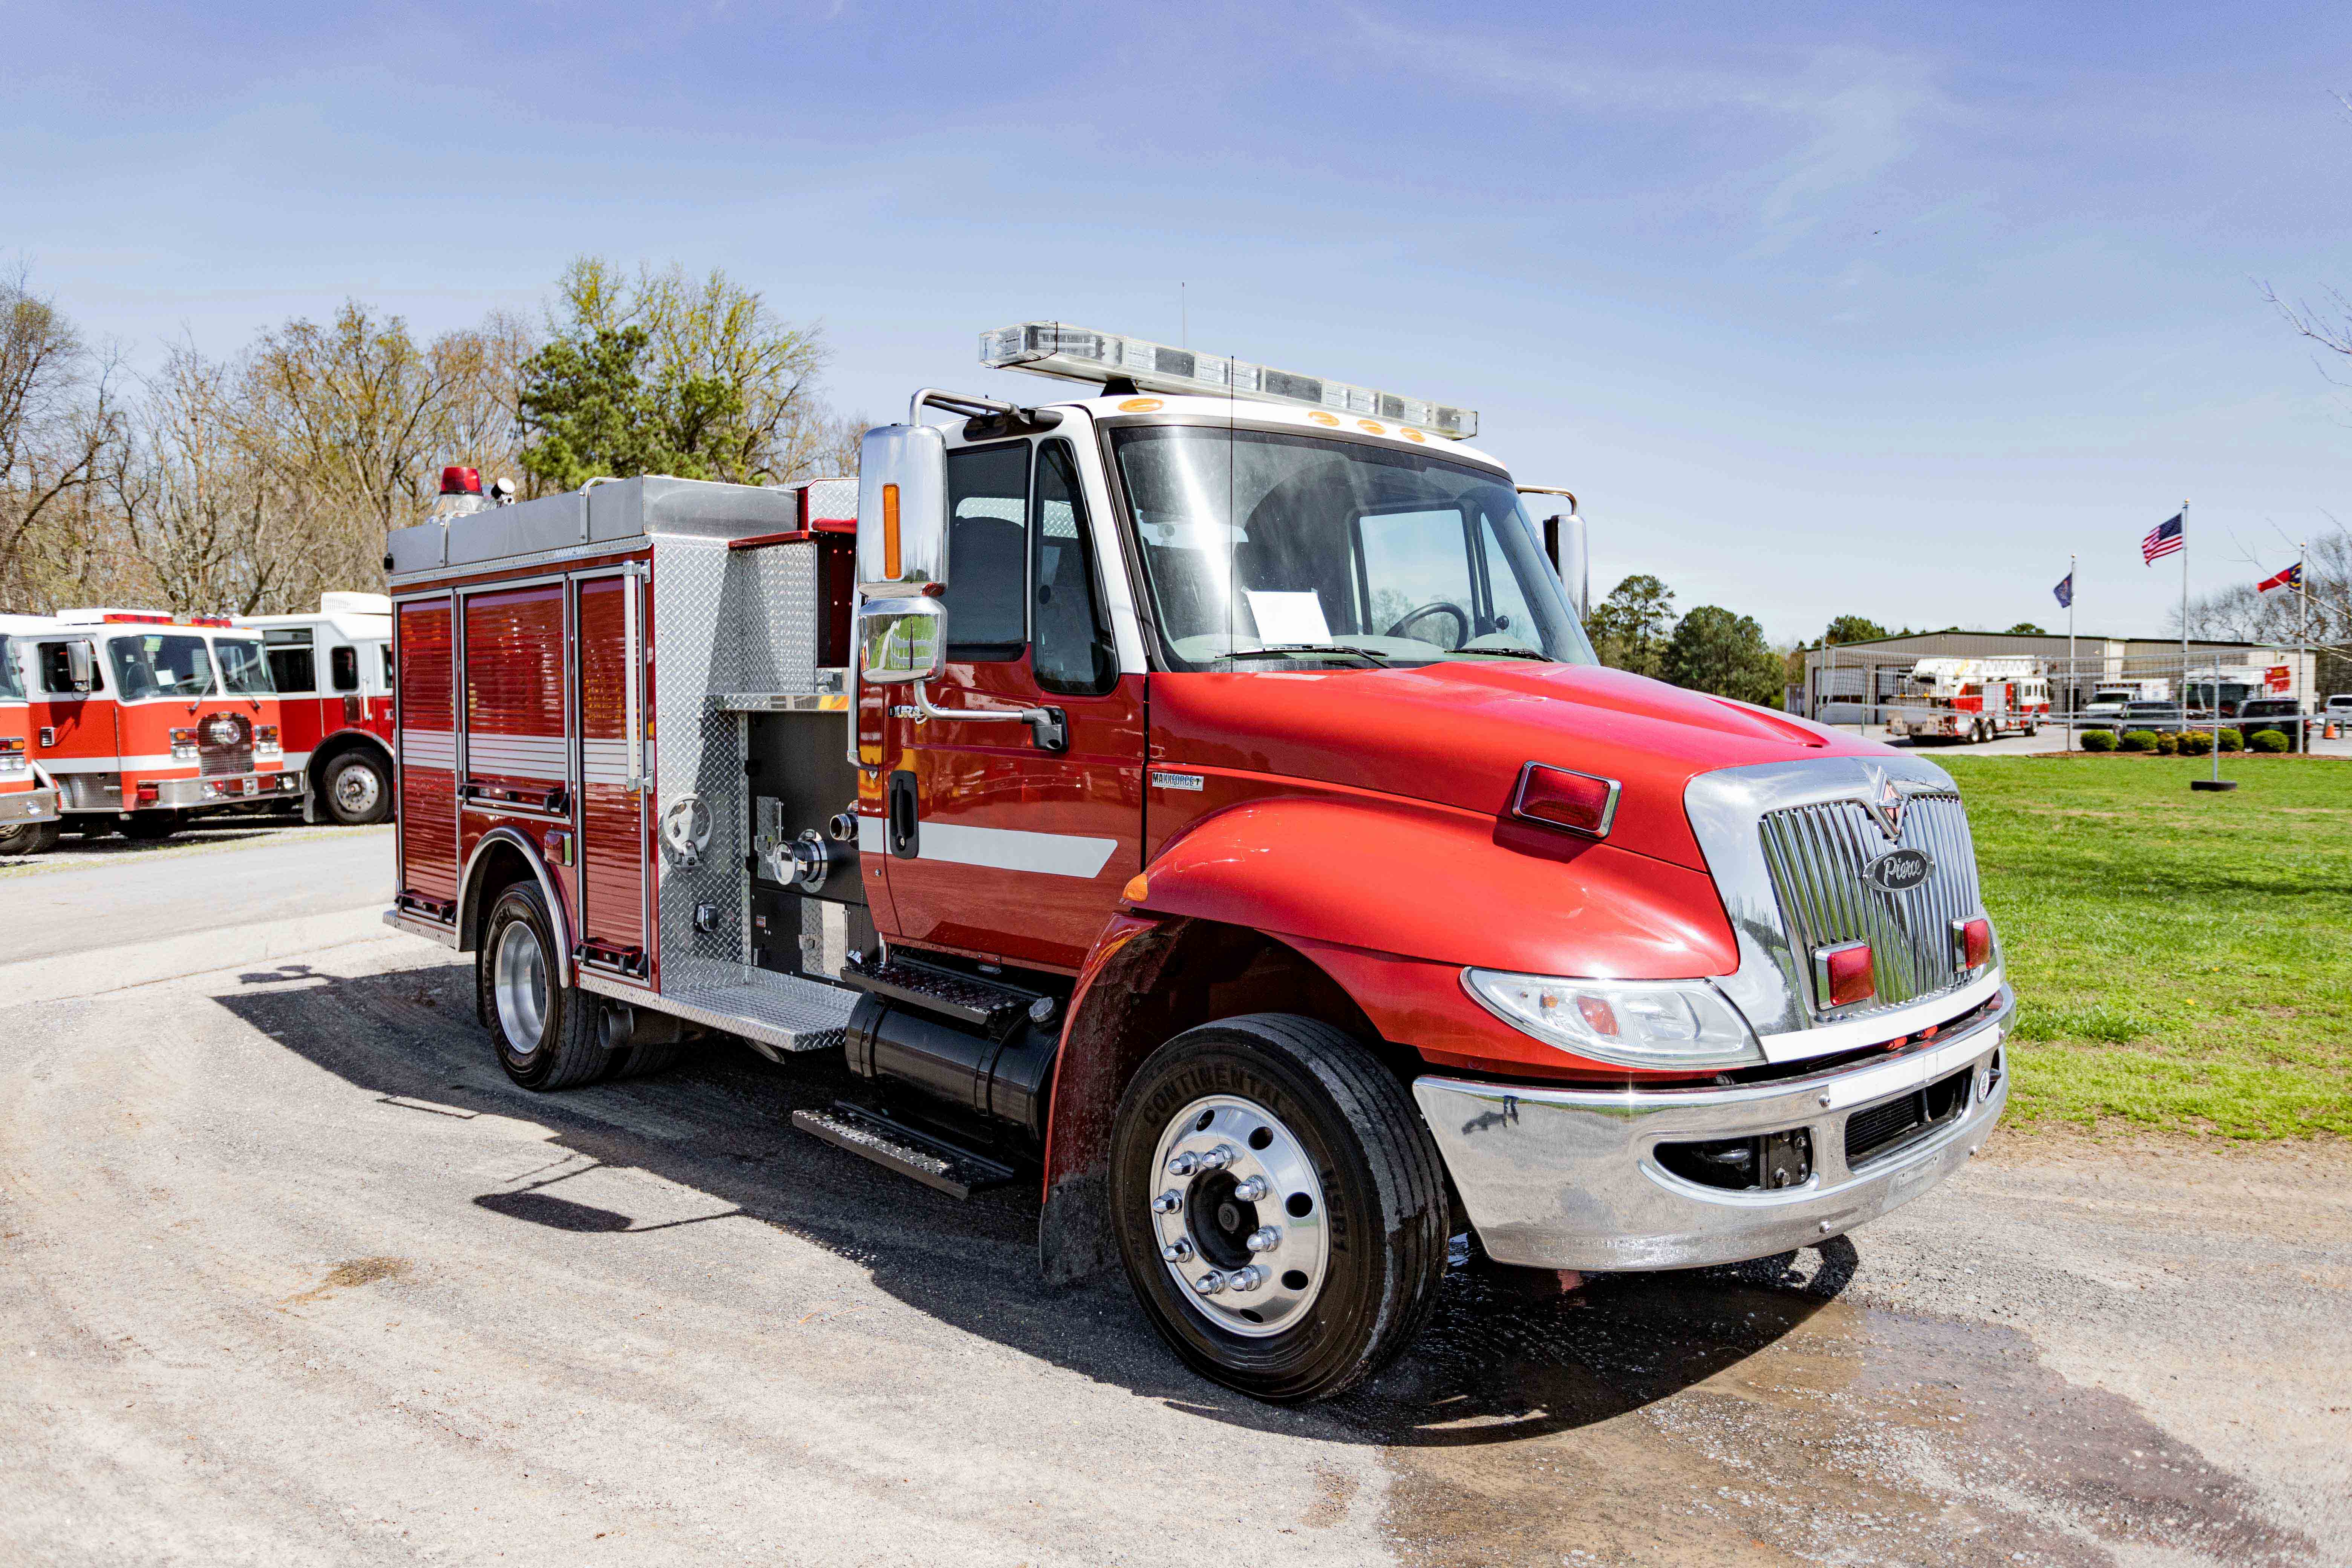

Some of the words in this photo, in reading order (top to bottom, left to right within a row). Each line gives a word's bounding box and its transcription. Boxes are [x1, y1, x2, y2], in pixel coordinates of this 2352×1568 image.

[1152, 773, 1194, 786] MAXXFORCE
[1883, 856, 1922, 887] Pierce
[1142, 1063, 1282, 1126] CONTINENTAL
